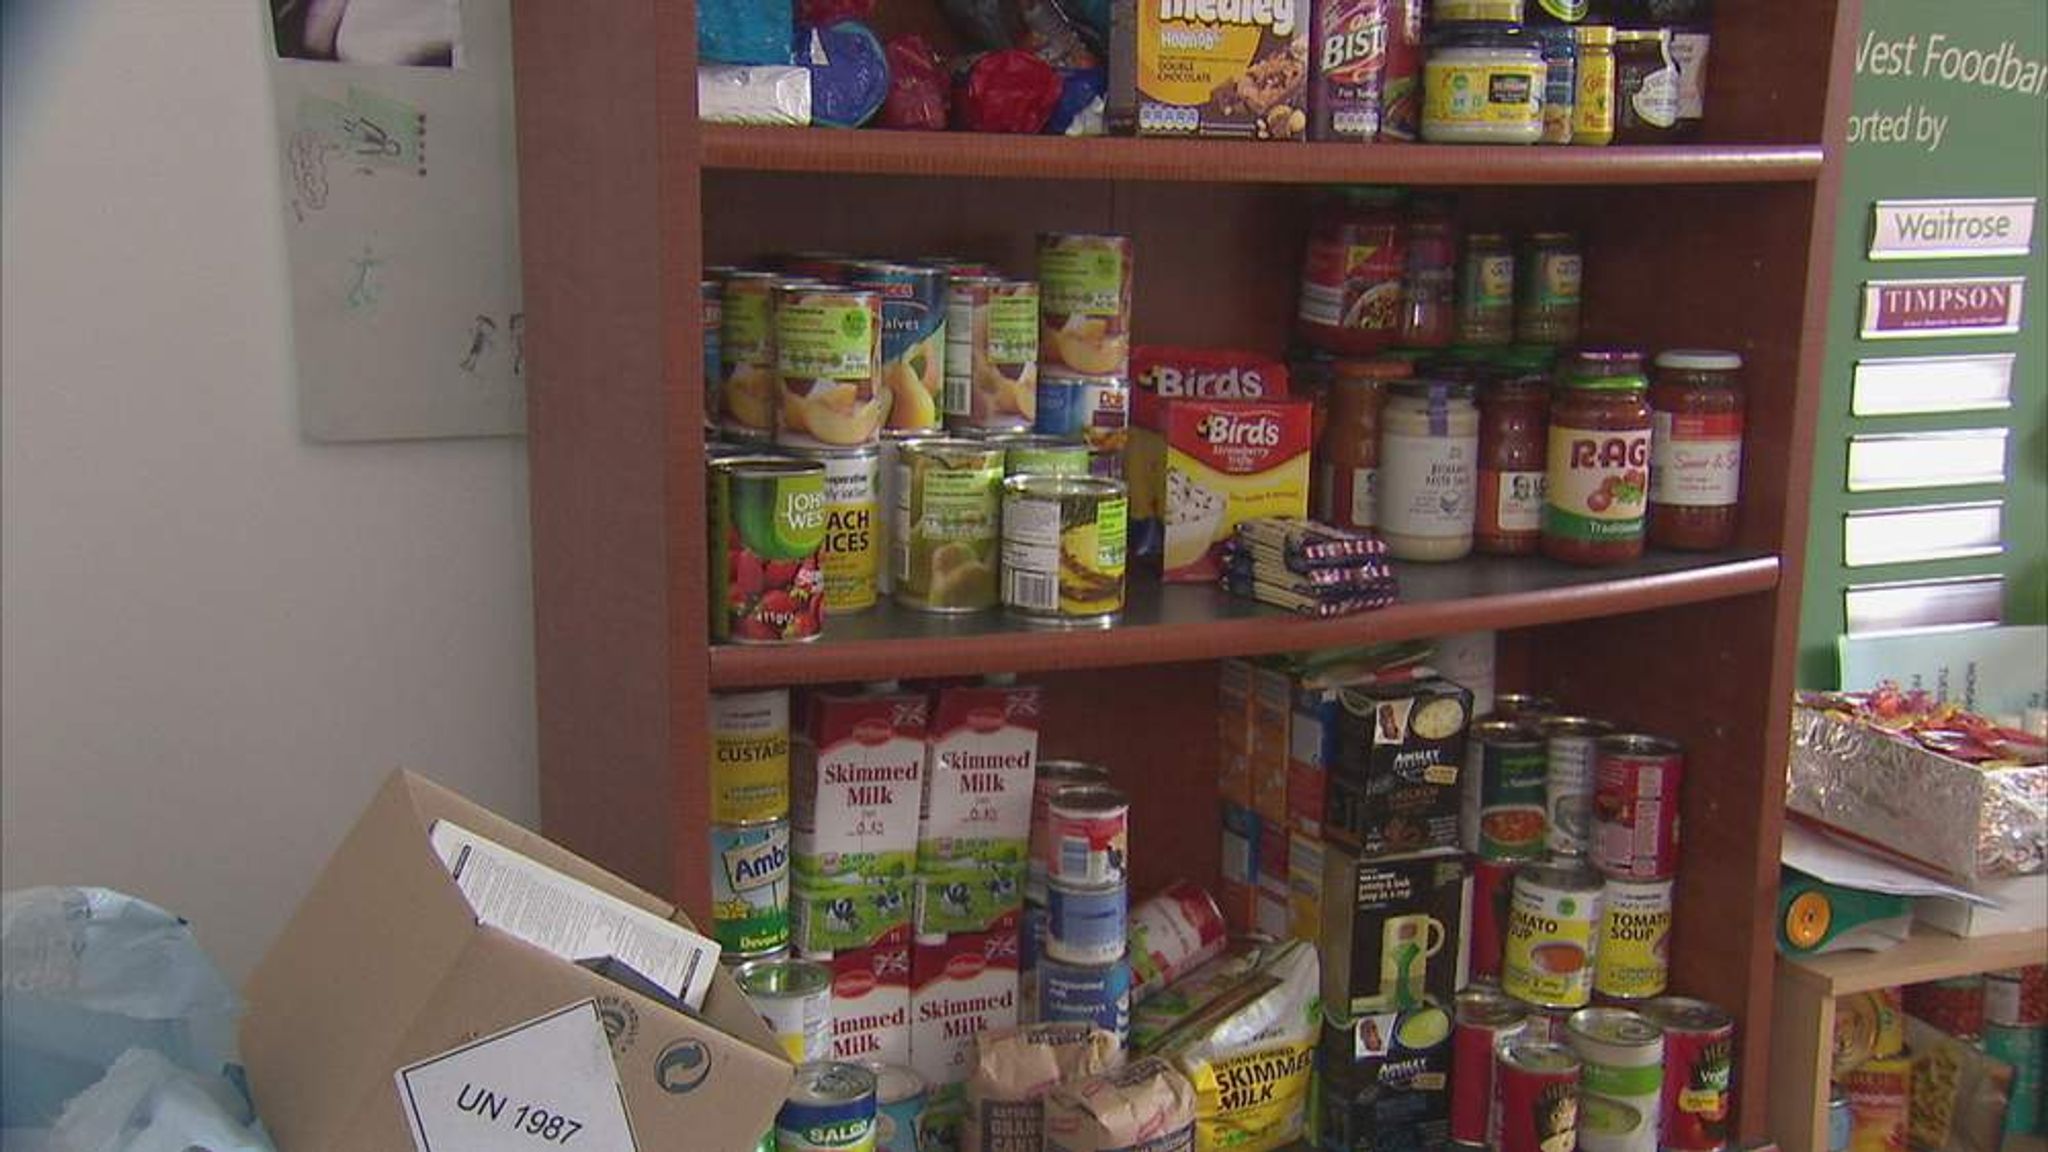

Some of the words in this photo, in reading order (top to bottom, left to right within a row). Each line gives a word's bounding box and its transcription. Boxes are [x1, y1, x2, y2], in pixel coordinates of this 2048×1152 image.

[1915, 106, 1948, 152] by
[1895, 210, 2011, 241] Waitrose
[1885, 286, 2006, 314] TIMPSON
[824, 762, 919, 785] Skimmed
[941, 751, 1031, 773] Skimmed
[847, 786, 893, 808] Milk
[959, 774, 1005, 794] Milk
[1609, 927, 1655, 942] SOUP
[919, 989, 1014, 1024] Skimmed
[833, 1007, 906, 1035] immed
[942, 1014, 989, 1042] Milk
[833, 1037, 881, 1059] Milk
[1219, 1082, 1275, 1110] MILK
[456, 1082, 508, 1121] UN
[513, 1105, 584, 1145] 1987
